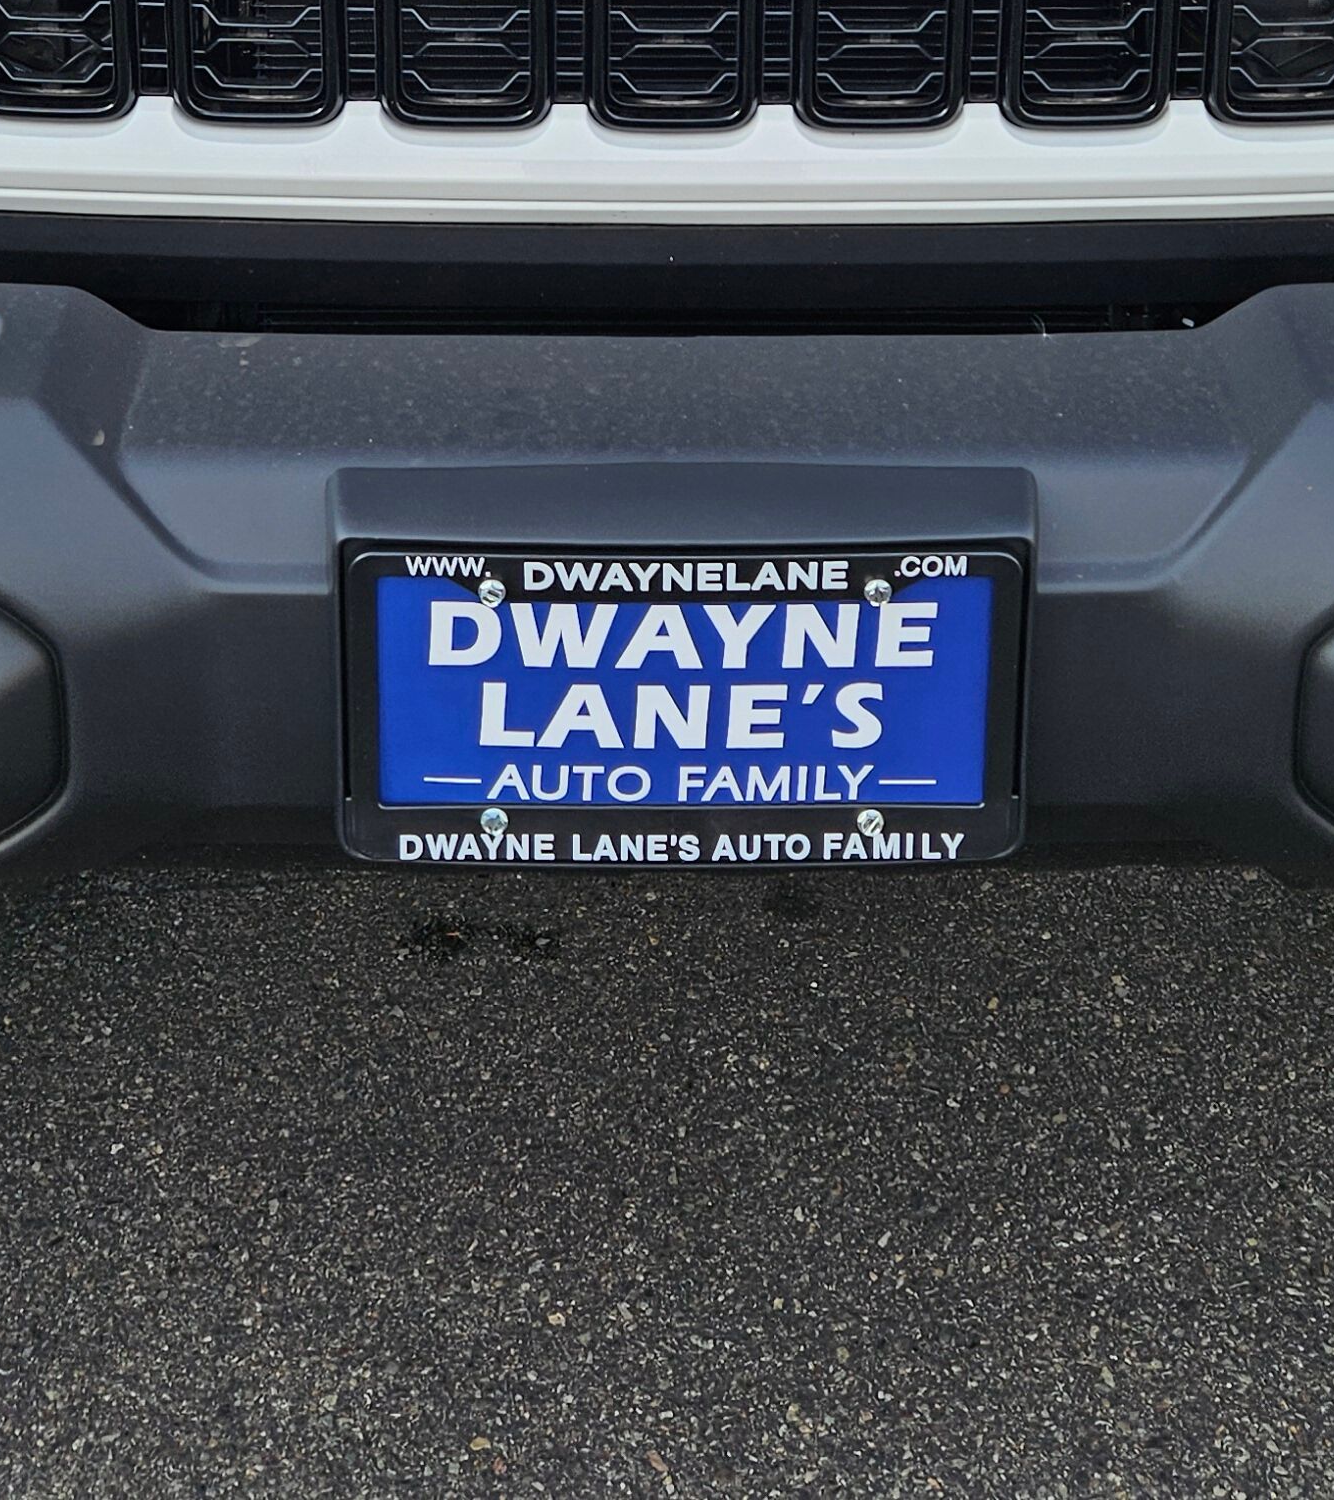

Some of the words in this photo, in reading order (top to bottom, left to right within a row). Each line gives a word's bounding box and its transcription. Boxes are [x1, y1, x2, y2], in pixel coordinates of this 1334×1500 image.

[405, 556, 492, 578] WWW.
[524, 561, 849, 593] DWAYNELANE
[893, 554, 968, 578] .COM
[428, 601, 939, 670] DWAYNE
[479, 682, 884, 750] LANE'S
[487, 764, 652, 803] AUTO
[677, 764, 876, 803] FAMILY
[399, 833, 556, 863] DWAYNE
[572, 834, 700, 863] LANE'S
[713, 833, 812, 862] AUTO
[823, 833, 965, 861] FAMILY
